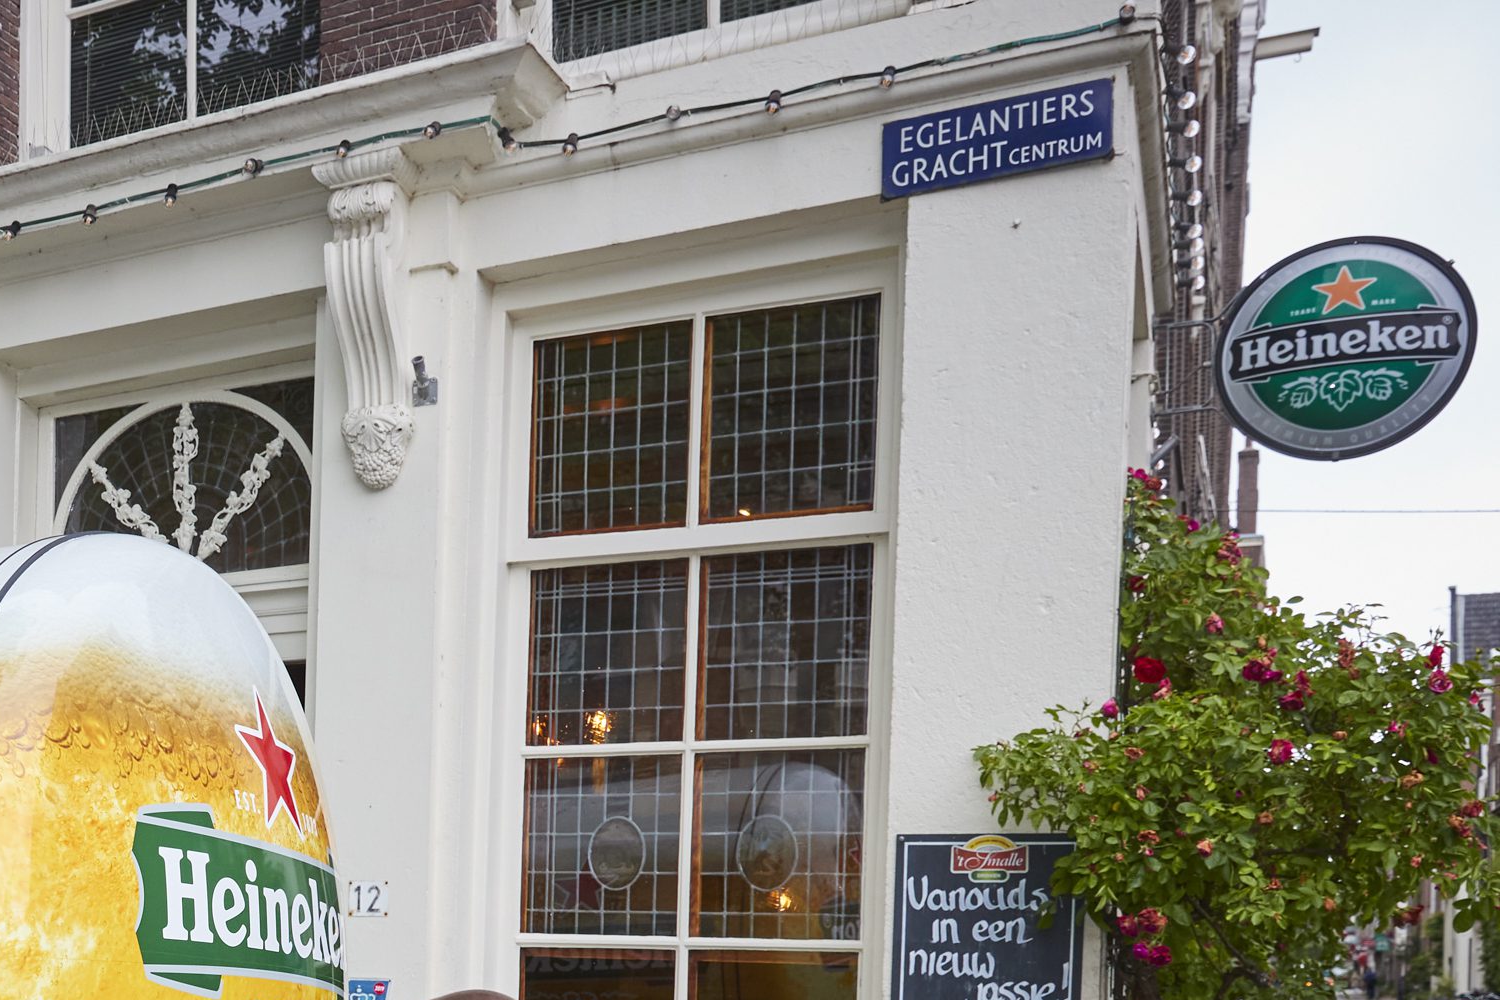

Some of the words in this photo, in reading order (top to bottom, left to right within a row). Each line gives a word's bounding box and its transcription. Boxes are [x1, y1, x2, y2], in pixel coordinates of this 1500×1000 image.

[900, 90, 1095, 153] EGELANTIERS
[891, 140, 1008, 187] GRACHT
[1008, 131, 1103, 165] CENTRUM
[1238, 320, 1451, 372] Heineken
[234, 788, 261, 815] EST.
[964, 850, 1025, 871] Smalle
[353, 885, 382, 913] 12
[931, 917, 961, 944] in
[972, 916, 1034, 944] een
[908, 947, 996, 979] nieuw
